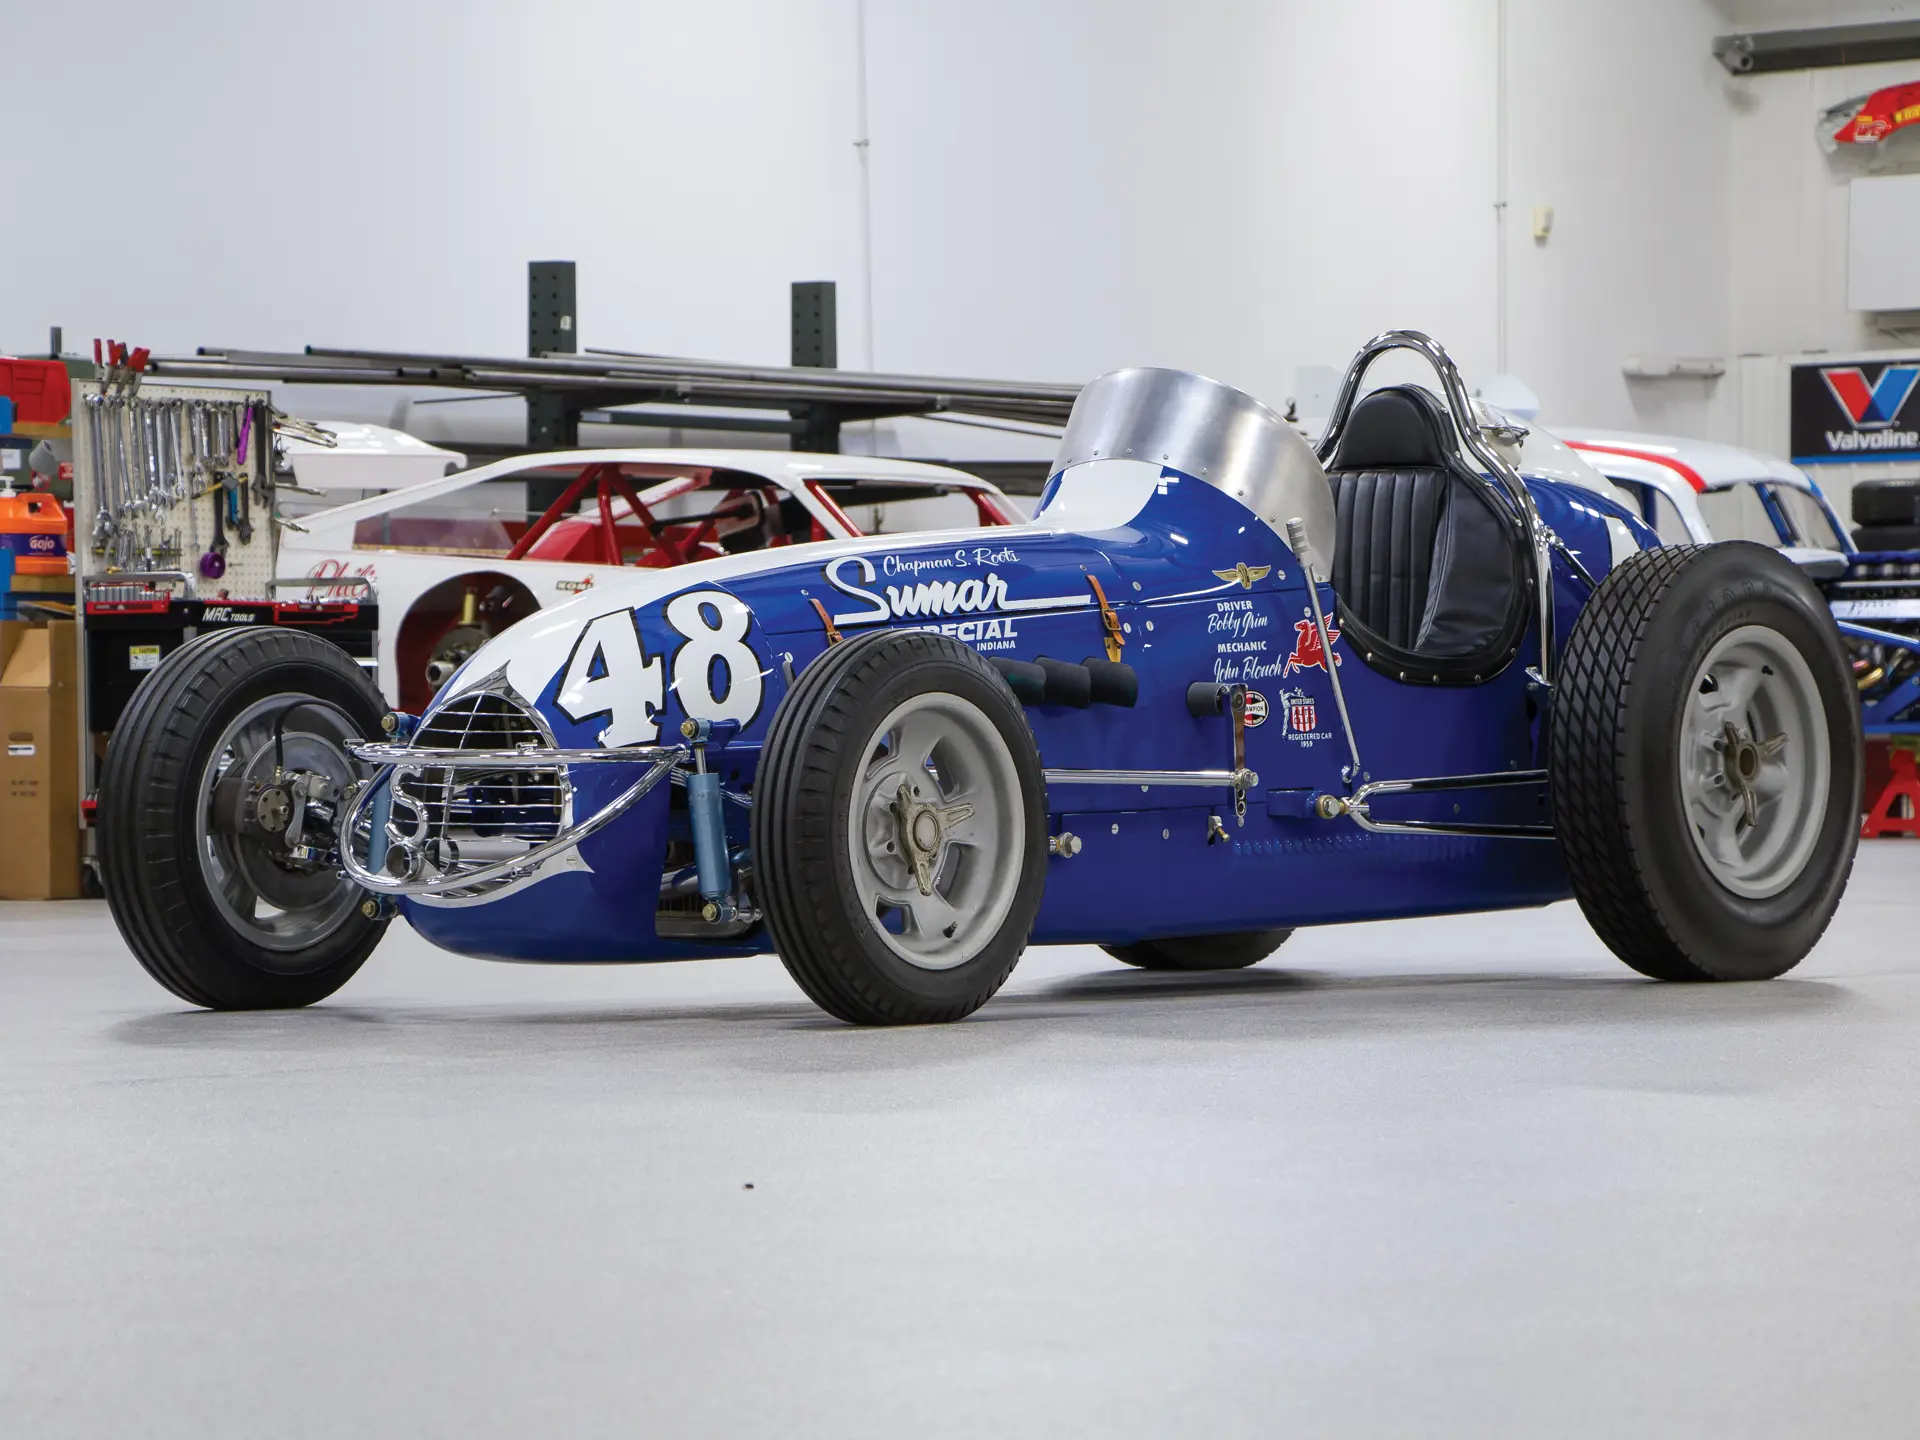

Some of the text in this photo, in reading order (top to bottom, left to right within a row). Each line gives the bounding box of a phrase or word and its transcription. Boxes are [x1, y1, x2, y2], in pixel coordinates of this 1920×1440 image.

[1824, 428, 1918, 451] Valvoline
[882, 555, 954, 577] Chapman
[954, 549, 972, 567] S.
[822, 555, 1010, 627] Sumar
[1216, 600, 1254, 612] DRIVER
[202, 607, 256, 622] MAC TOOLS
[1207, 611, 1269, 638] Bobby Grim
[976, 640, 1016, 651] INDIANA
[1217, 641, 1267, 653] MECHANIC
[552, 588, 765, 748] 48
[1213, 658, 1239, 683] John
[1293, 708, 1314, 716] AUTO
[1293, 717, 1314, 725] CLUB
[1287, 732, 1320, 740] REGISTERED
[1300, 740, 1314, 748] 1959
